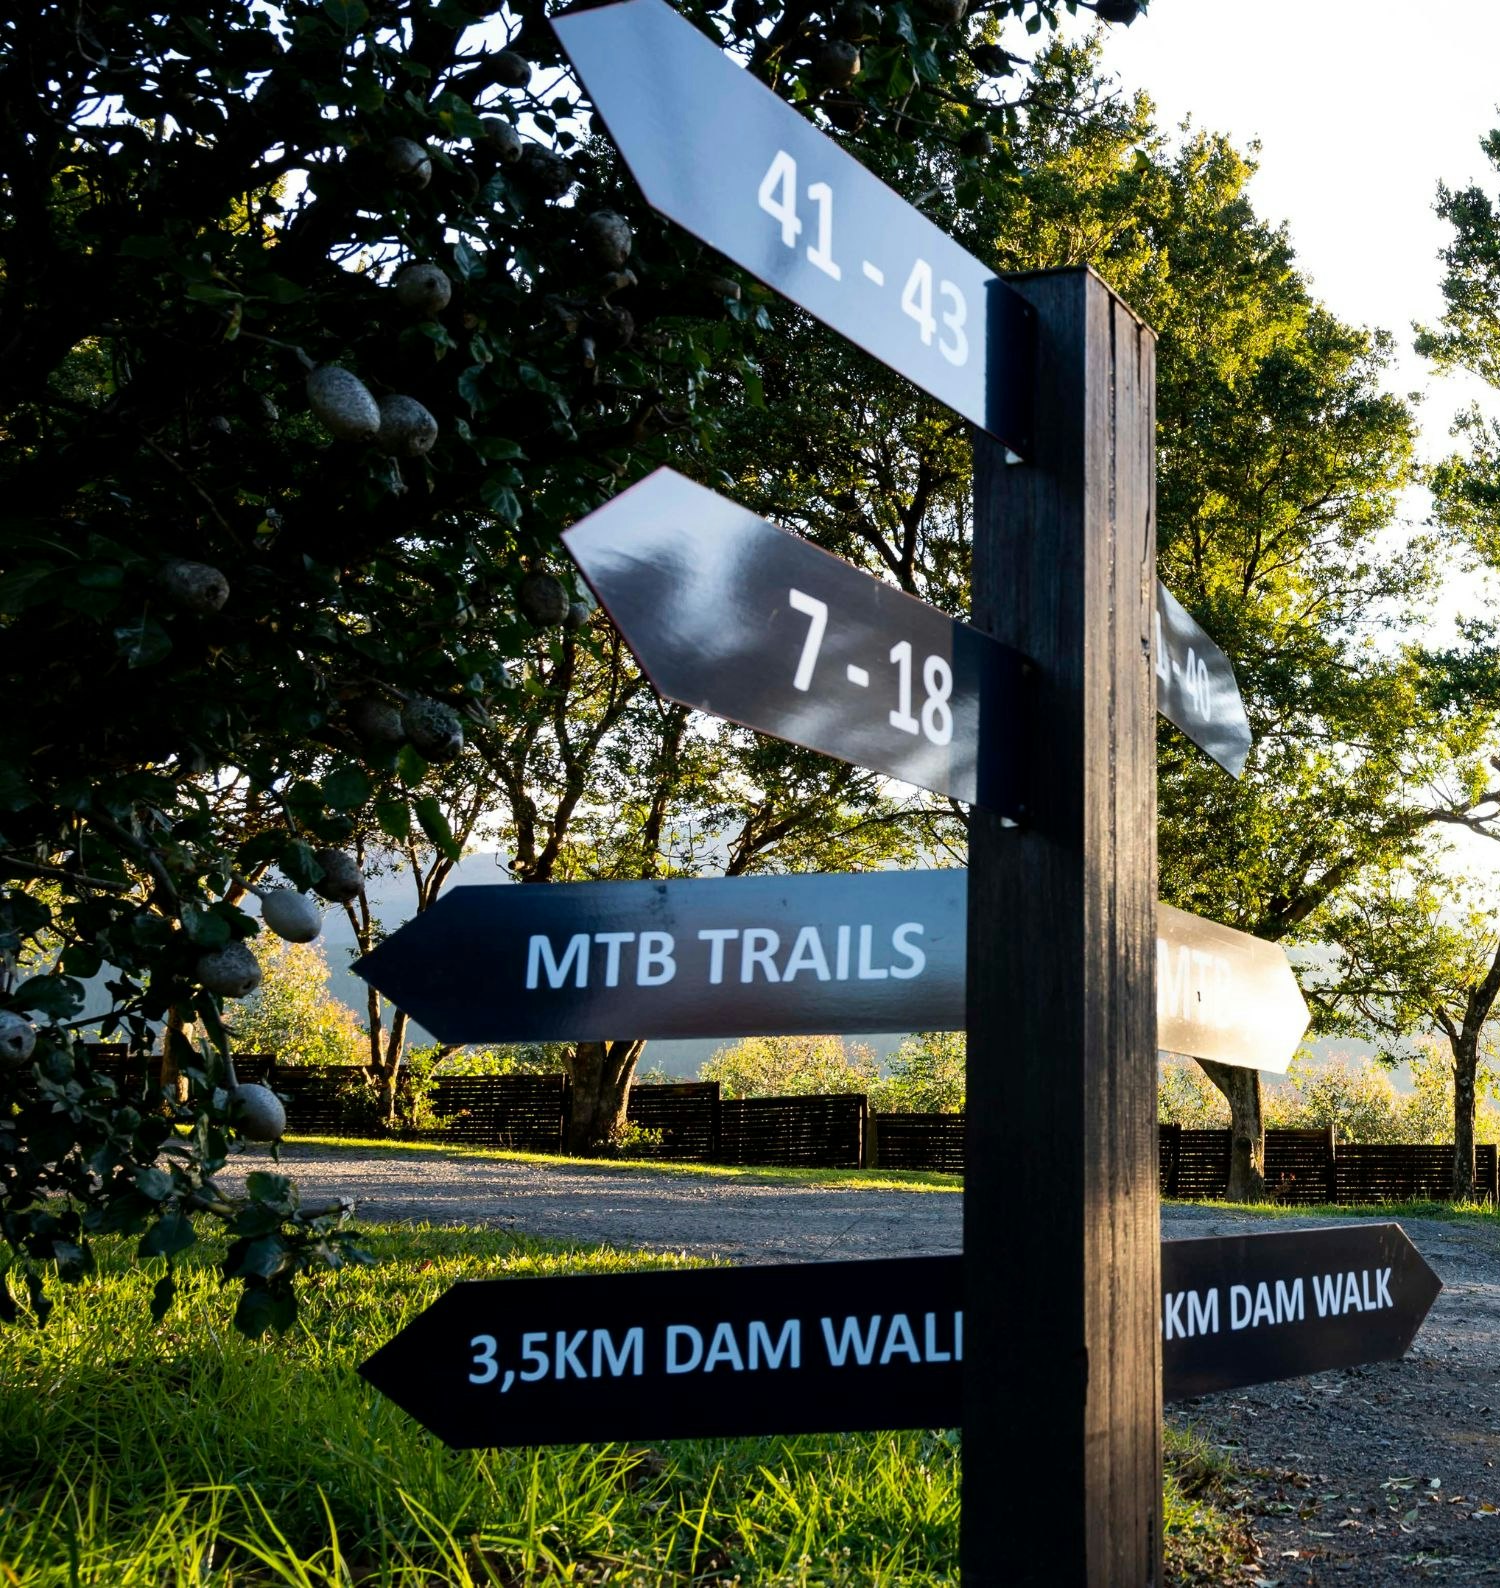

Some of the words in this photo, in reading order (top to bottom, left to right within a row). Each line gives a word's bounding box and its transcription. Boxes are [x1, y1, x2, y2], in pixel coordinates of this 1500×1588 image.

[758, 149, 842, 281] 41
[901, 258, 969, 367] 43
[788, 588, 829, 692] 7
[888, 640, 953, 747] 18
[1186, 646, 1211, 721] 40
[525, 930, 677, 989] MTB
[698, 921, 926, 985] TRAILS
[1159, 1287, 1218, 1340] KM
[1229, 1277, 1304, 1331] DAM
[1312, 1267, 1393, 1318] WALK
[467, 1326, 643, 1393] 3,5KM
[665, 1319, 800, 1374] DAM
